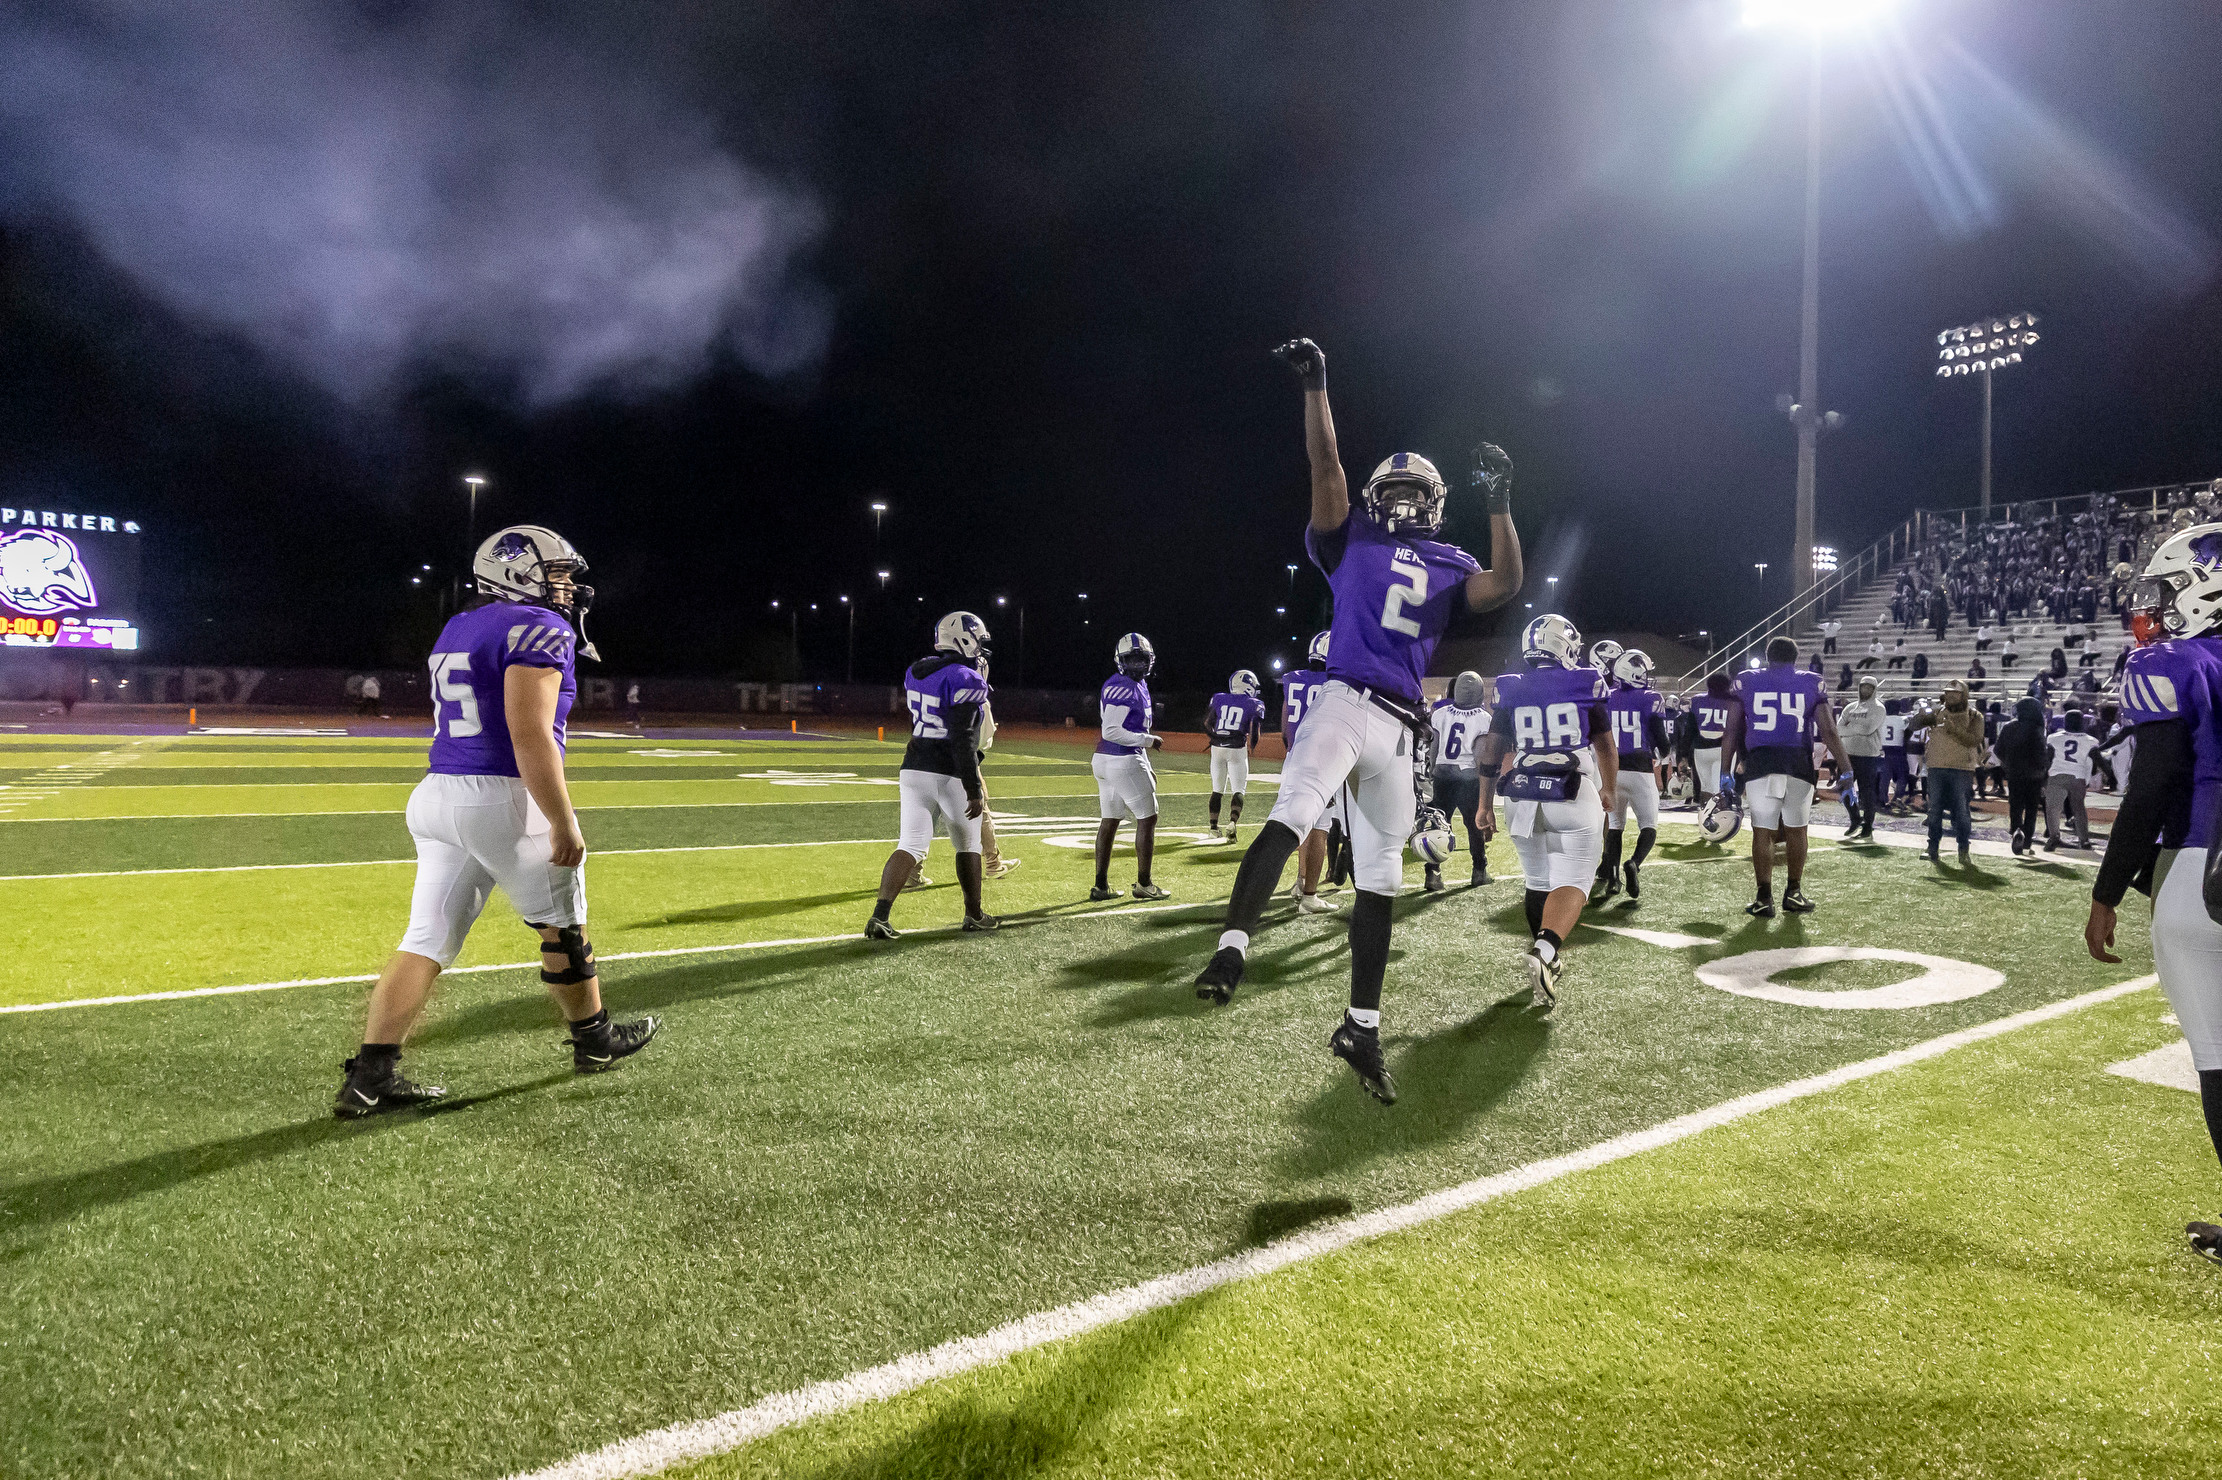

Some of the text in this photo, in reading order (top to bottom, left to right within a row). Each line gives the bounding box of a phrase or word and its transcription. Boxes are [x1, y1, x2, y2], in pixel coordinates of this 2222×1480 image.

[1, 507, 117, 532] PARKER
[1381, 558, 1429, 639] 2
[736, 681, 814, 712] THE
[1217, 704, 1244, 731] 10
[1699, 707, 1728, 729] 74
[1753, 691, 1806, 733] 54
[1444, 721, 1466, 760] 6
[1885, 725, 1894, 741] 3
[2064, 739, 2078, 763] 2
